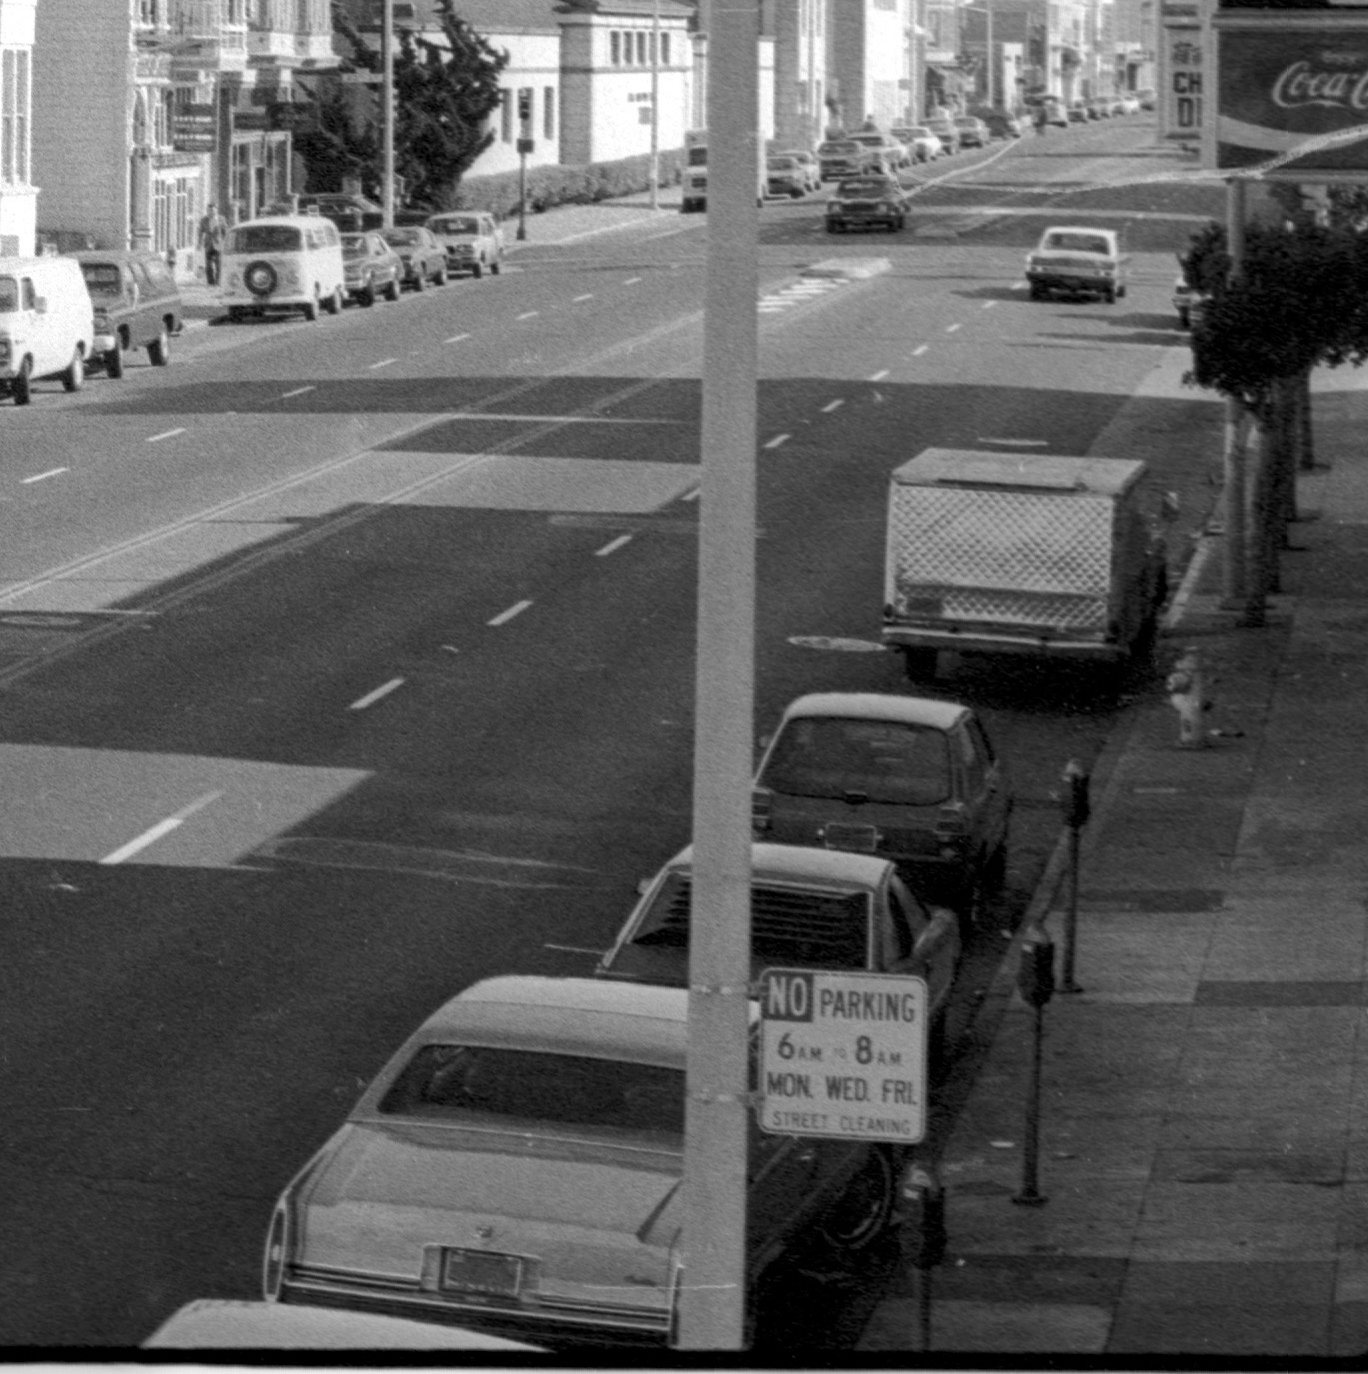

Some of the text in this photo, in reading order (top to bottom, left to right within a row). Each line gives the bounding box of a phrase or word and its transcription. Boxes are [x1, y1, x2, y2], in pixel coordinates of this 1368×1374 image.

[768, 976, 915, 1023] NO PARKING
[778, 1032, 795, 1060] 6
[856, 1035, 873, 1065] 8
[767, 1071, 918, 1105] MON. WED. FRI.
[772, 1110, 912, 1136] STREET CLEANING
